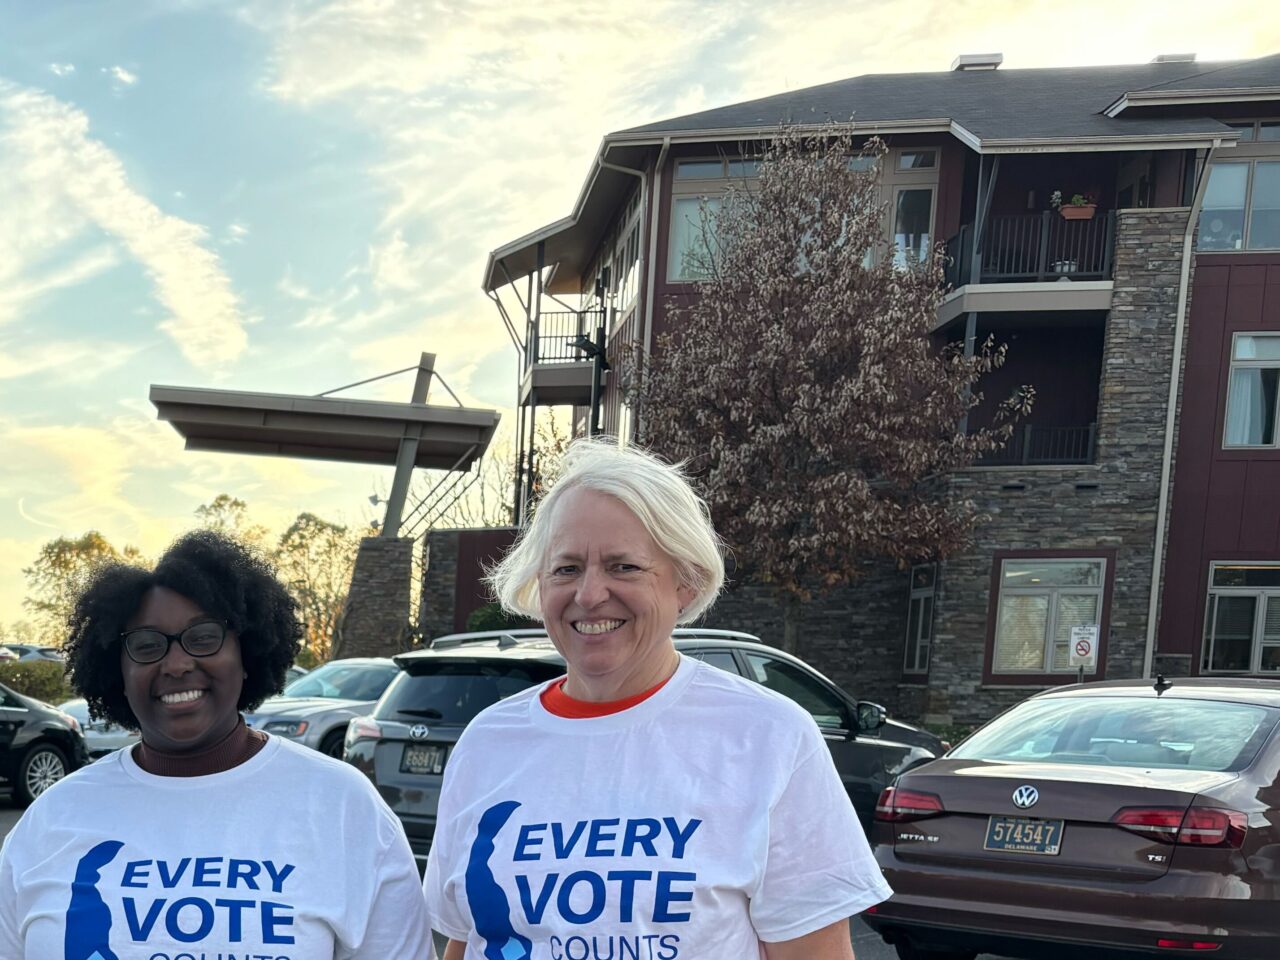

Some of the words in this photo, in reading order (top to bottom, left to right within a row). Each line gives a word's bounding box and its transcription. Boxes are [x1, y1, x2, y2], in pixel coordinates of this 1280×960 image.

[512, 817, 703, 861] EVERY
[897, 833, 925, 842] JETTA
[993, 822, 1055, 845] 574547
[120, 856, 296, 893] EVERY
[514, 870, 697, 924] VOTE
[122, 897, 296, 945] VOTE
